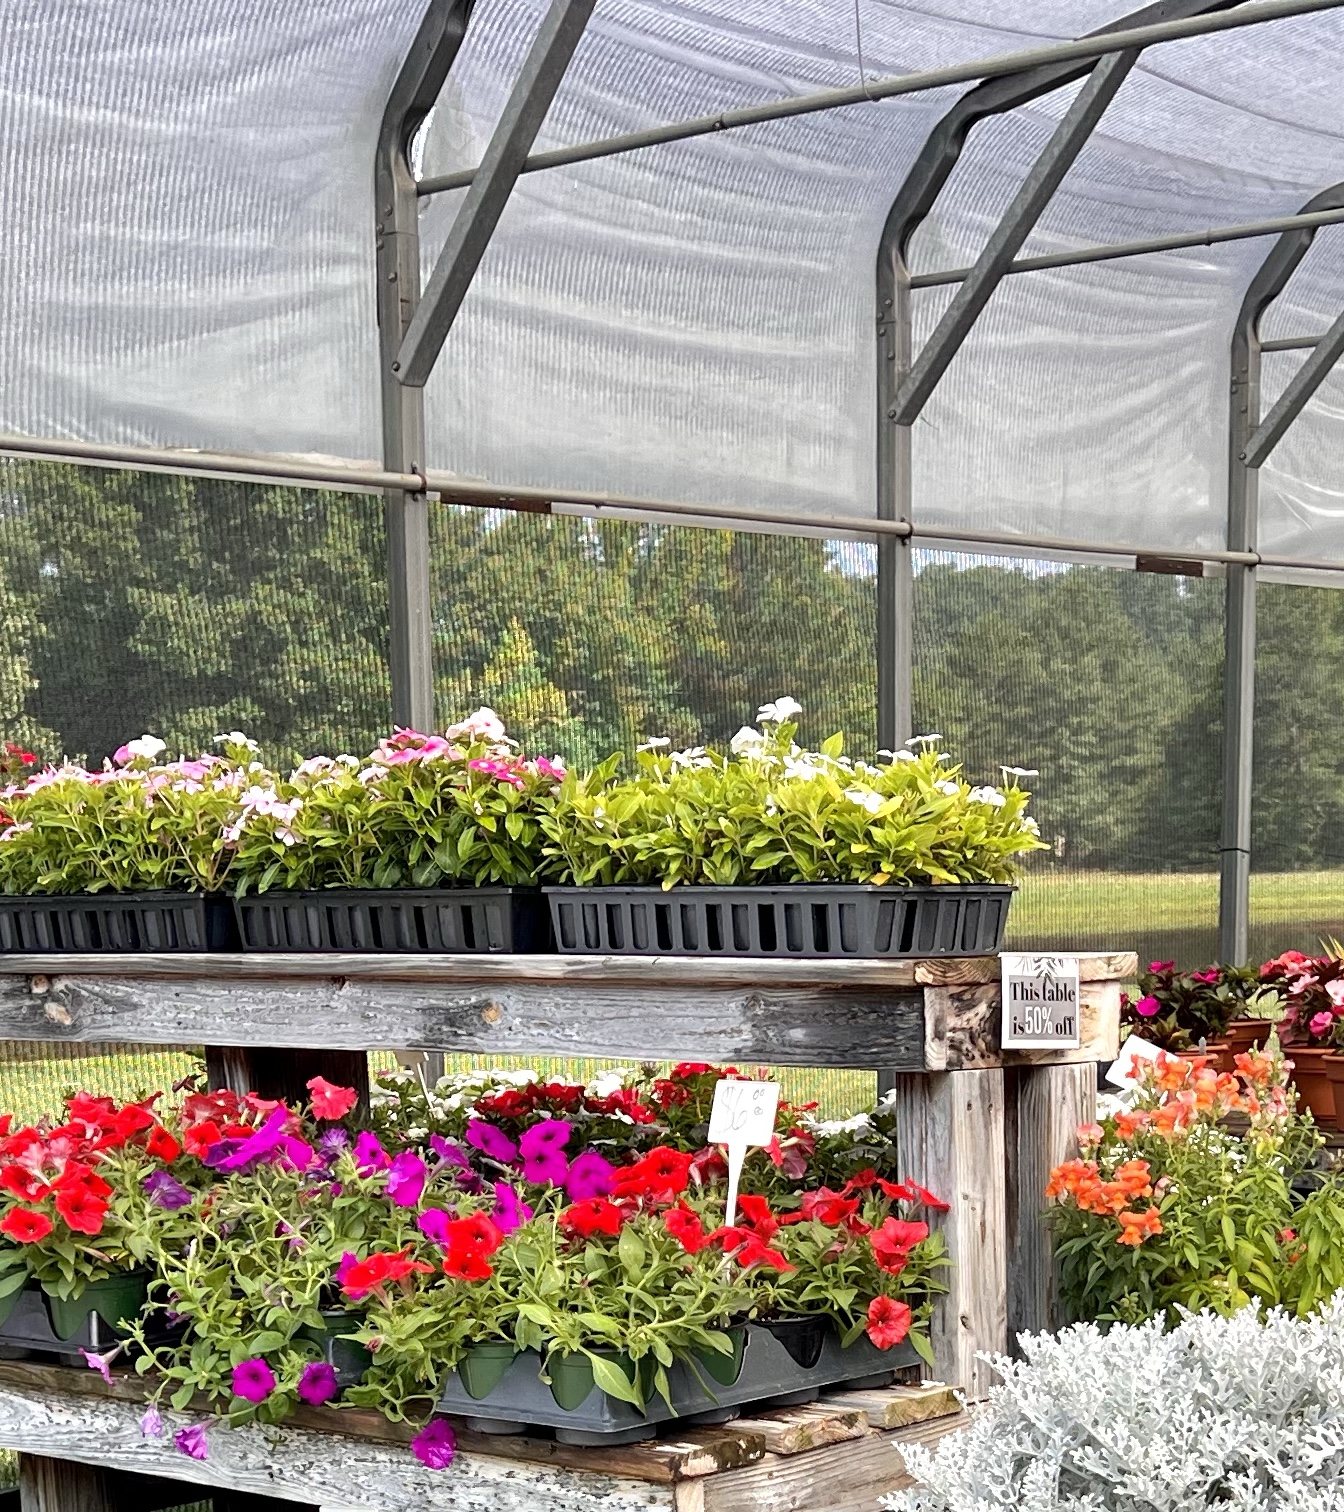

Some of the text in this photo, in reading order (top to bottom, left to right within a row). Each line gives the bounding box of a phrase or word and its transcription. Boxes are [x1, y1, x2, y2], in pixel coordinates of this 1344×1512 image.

[1009, 981, 1076, 1002] This table
[1013, 1006, 1074, 1035] is 50% off
